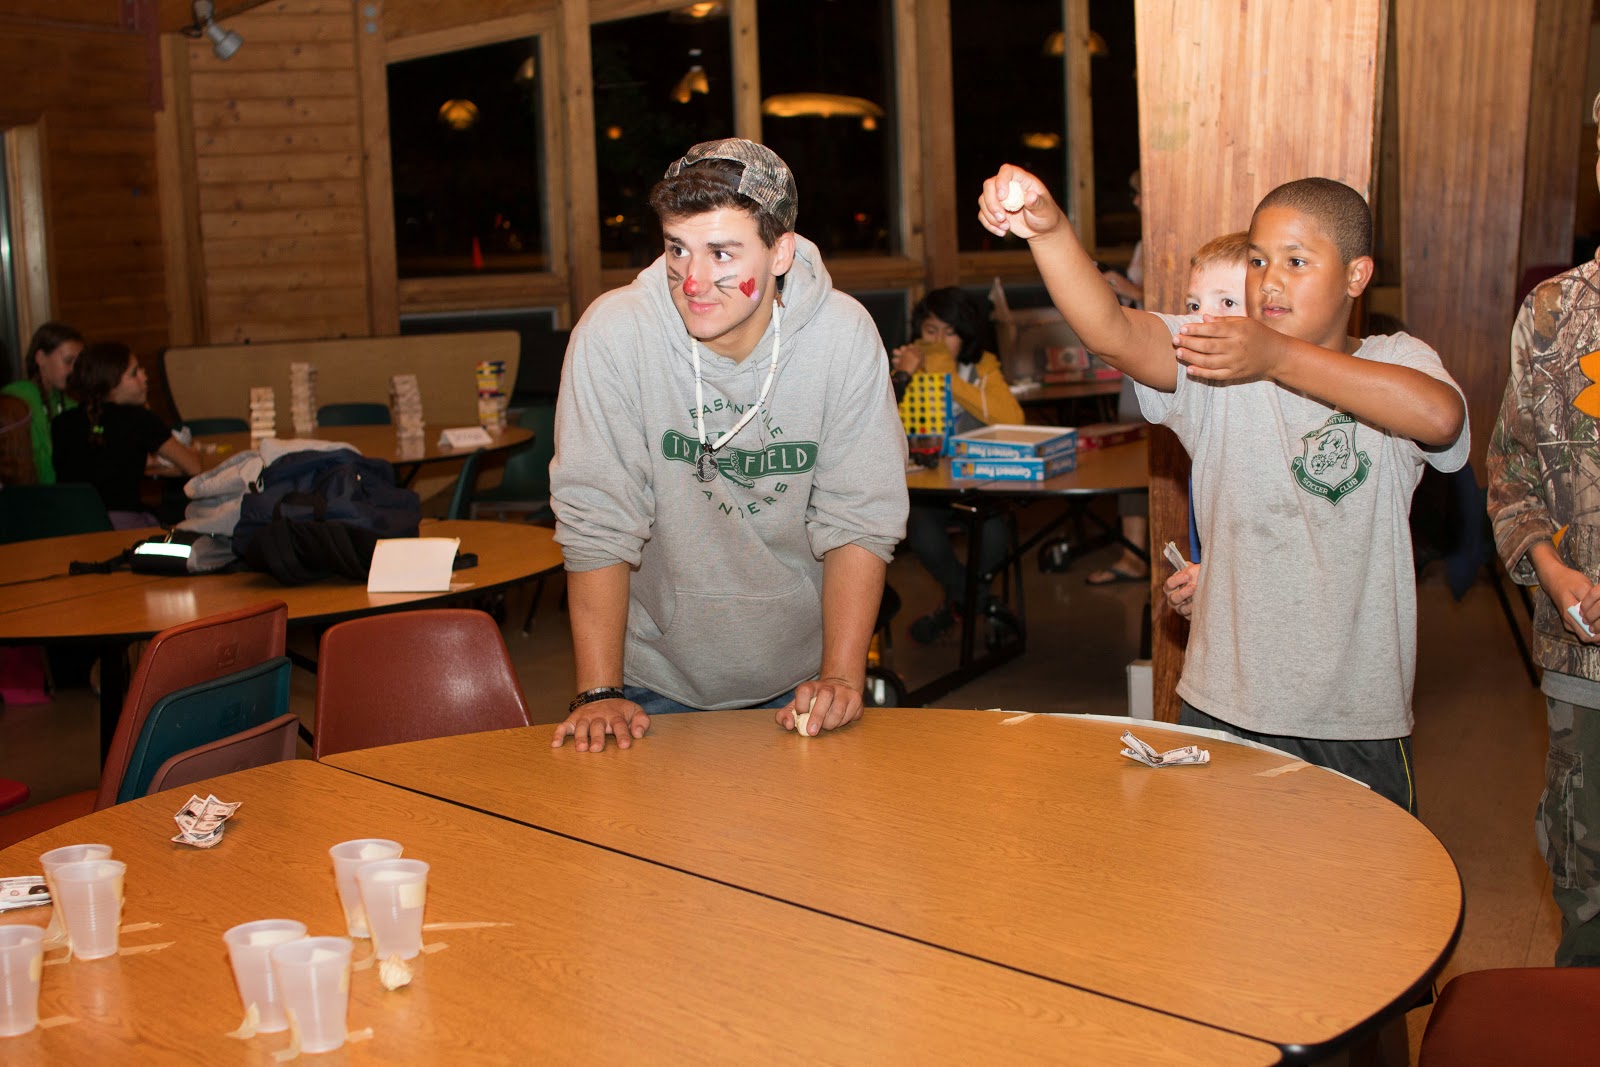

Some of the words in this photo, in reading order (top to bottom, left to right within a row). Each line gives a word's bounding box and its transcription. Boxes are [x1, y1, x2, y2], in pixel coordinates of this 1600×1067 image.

[744, 447, 808, 474] FIELD
[1302, 477, 1329, 495] SOCCER
[1339, 478, 1359, 493] CLUB
